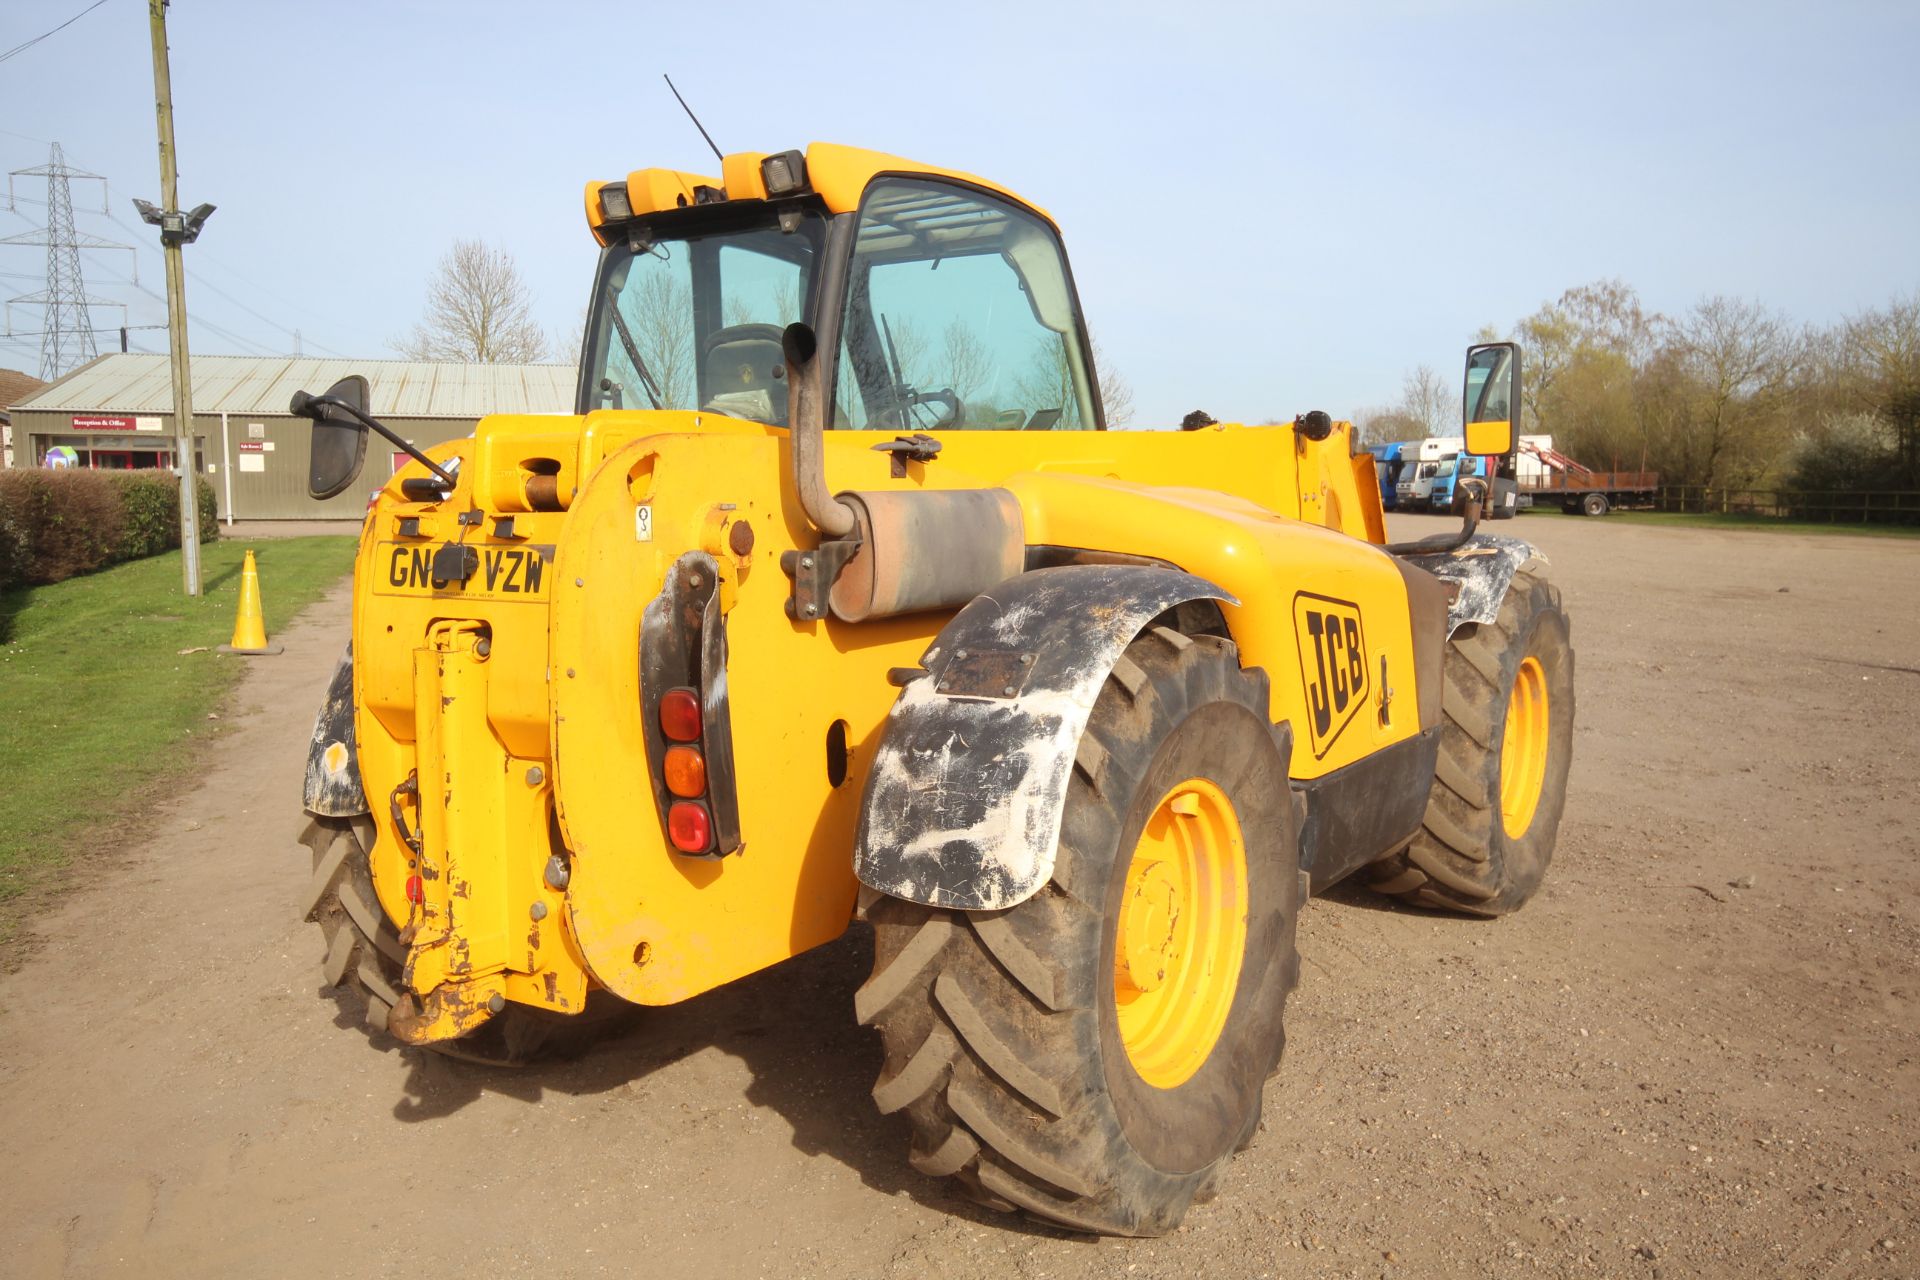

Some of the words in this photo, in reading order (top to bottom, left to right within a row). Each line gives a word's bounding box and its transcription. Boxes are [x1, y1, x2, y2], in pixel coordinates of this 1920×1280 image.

[74, 419, 101, 427] Reception
[390, 547, 469, 591] GN
[485, 550, 544, 593] VZW
[1305, 610, 1364, 738] JCB
